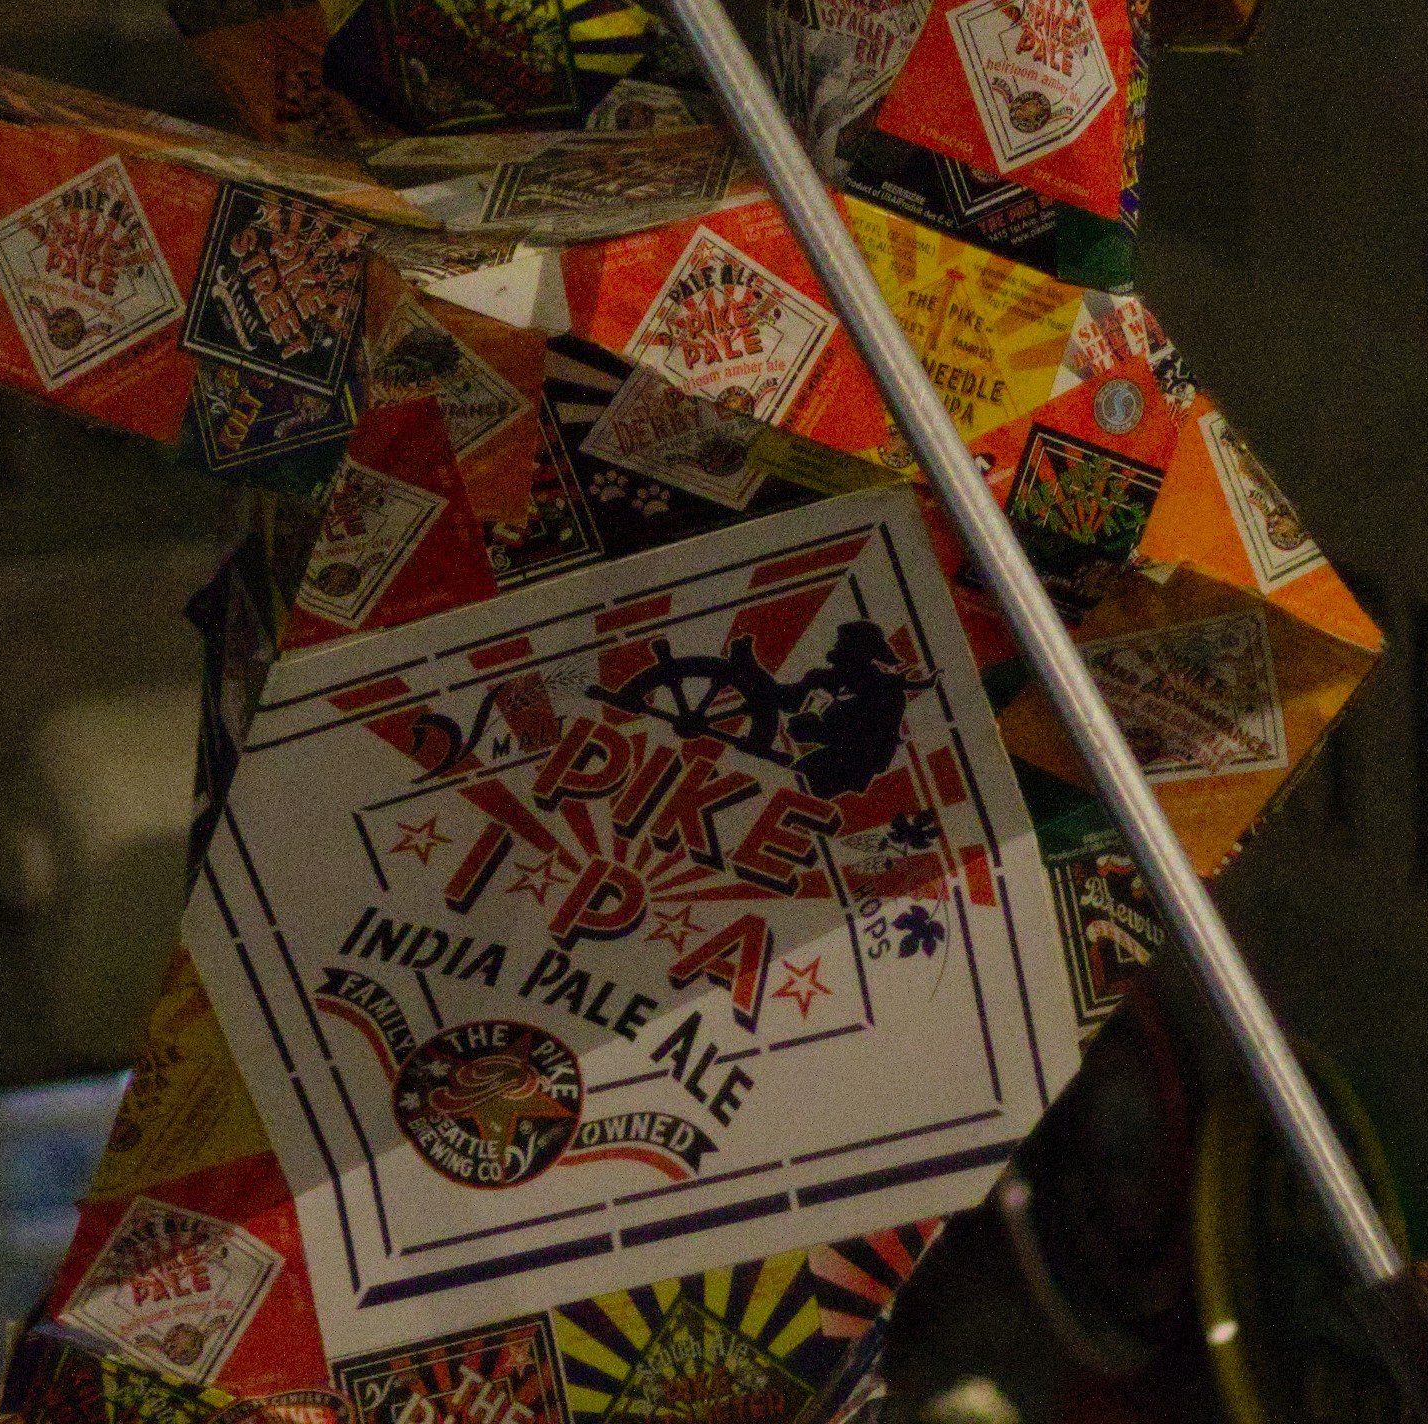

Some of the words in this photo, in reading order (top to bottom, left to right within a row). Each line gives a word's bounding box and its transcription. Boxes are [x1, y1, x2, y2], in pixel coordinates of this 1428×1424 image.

[984, 58, 1039, 81] heirloom
[1015, 32, 1074, 78] PALE
[45, 246, 120, 296] PALE
[669, 265, 716, 305] PALE
[720, 263, 760, 289] ALE
[905, 290, 937, 312] THE
[682, 326, 765, 371] PALE
[724, 361, 764, 379] amber
[491, 716, 569, 759] MALT
[532, 715, 844, 898] PIKE
[853, 883, 892, 962] HOPS
[336, 973, 417, 1057] FAMILY
[338, 907, 508, 988] INDIA
[518, 950, 658, 1042] PALE
[650, 1012, 756, 1127] ALE
[442, 1022, 511, 1058] THE
[532, 1038, 580, 1102] PIKE
[406, 1117, 475, 1181] BREWING
[429, 1110, 502, 1161] SEATTLE
[578, 1113, 697, 1153] OWNED
[130, 1264, 212, 1308] PALE
